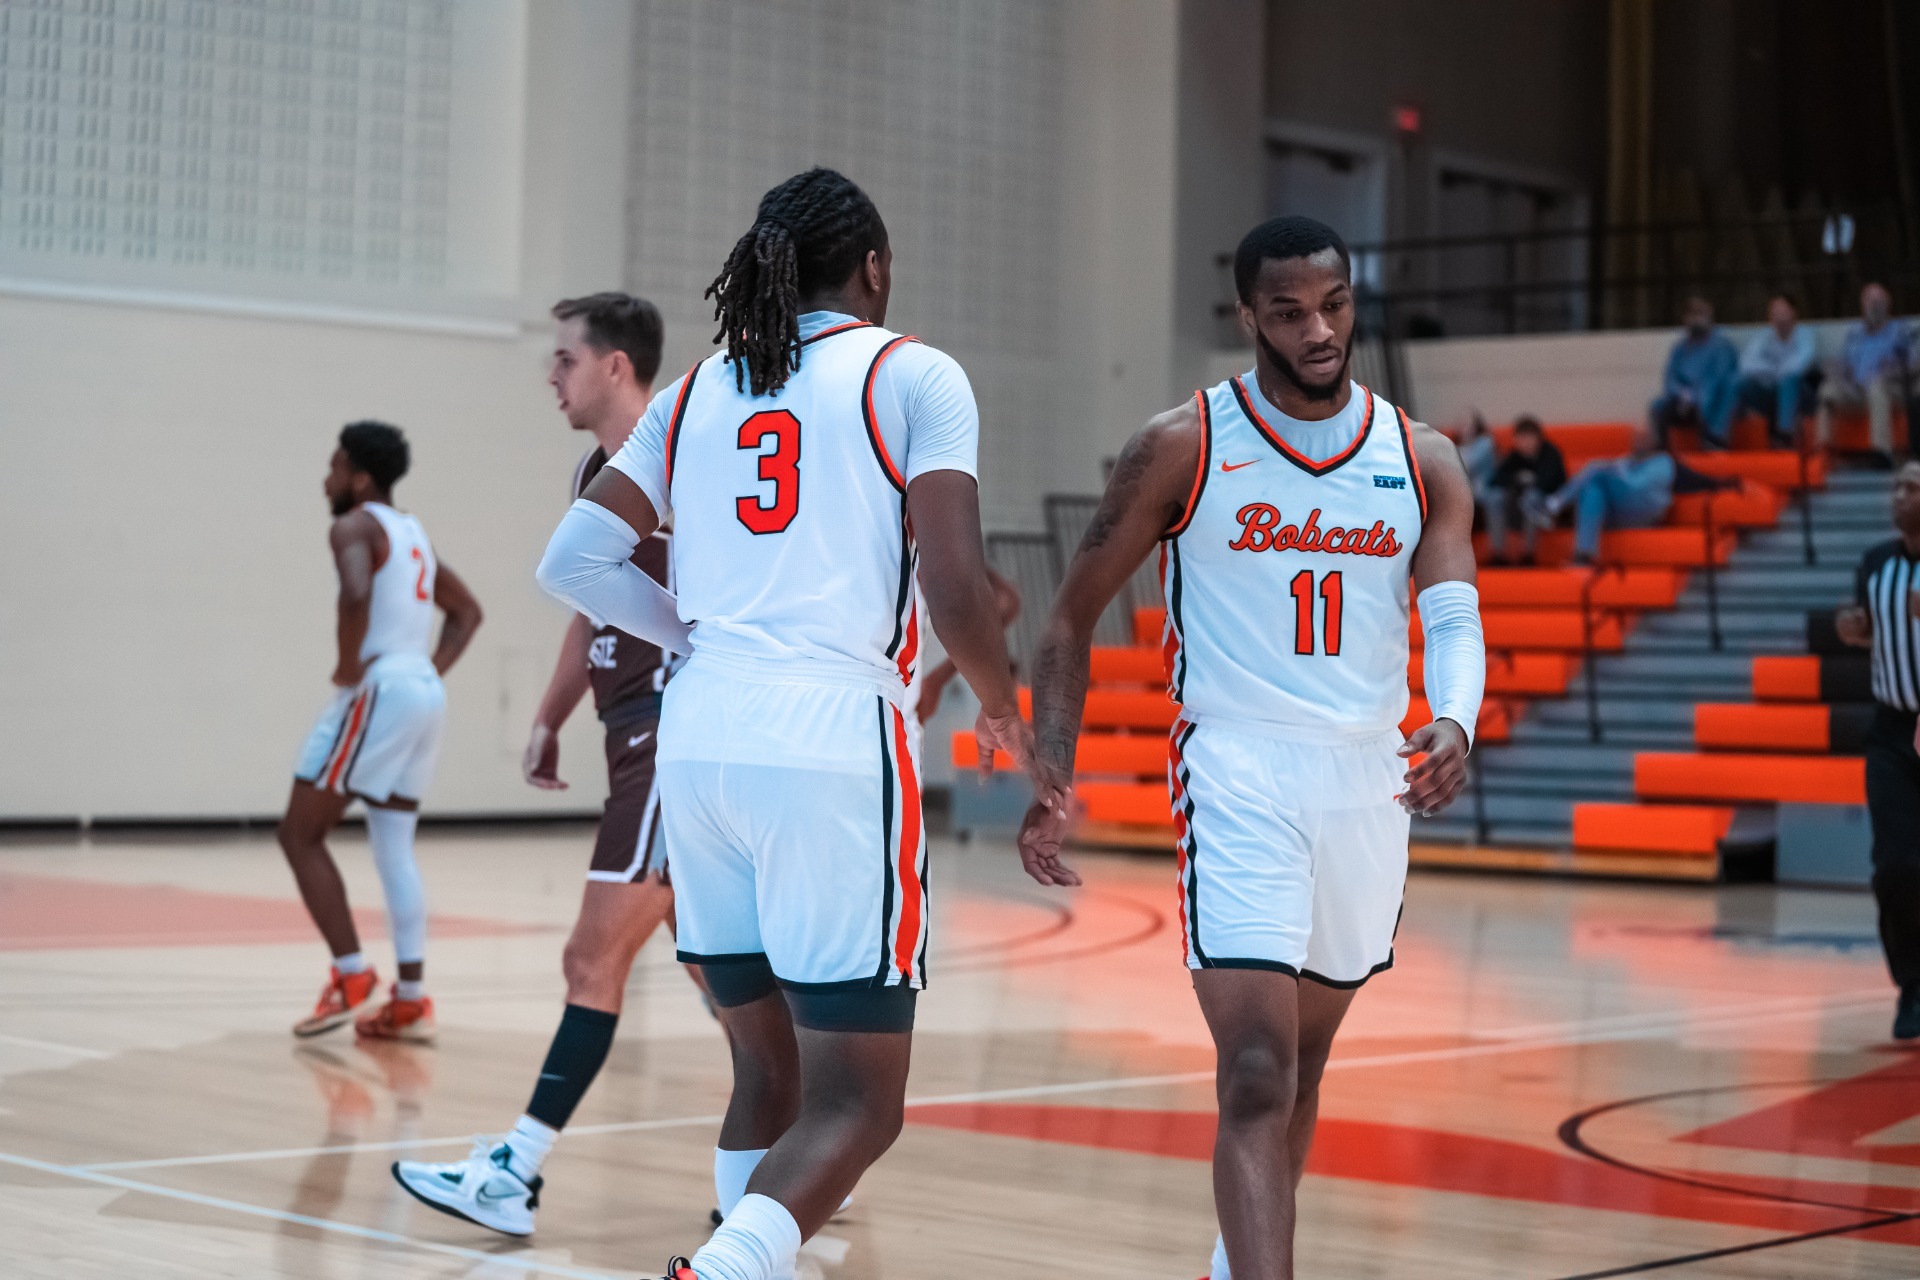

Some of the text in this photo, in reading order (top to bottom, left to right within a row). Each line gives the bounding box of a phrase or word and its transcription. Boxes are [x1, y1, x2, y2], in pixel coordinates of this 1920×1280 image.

[736, 408, 802, 536] 3
[1373, 480, 1406, 490] EAST
[1229, 502, 1403, 557] Bobcats
[410, 546, 428, 601] 2
[1290, 569, 1343, 657] 11
